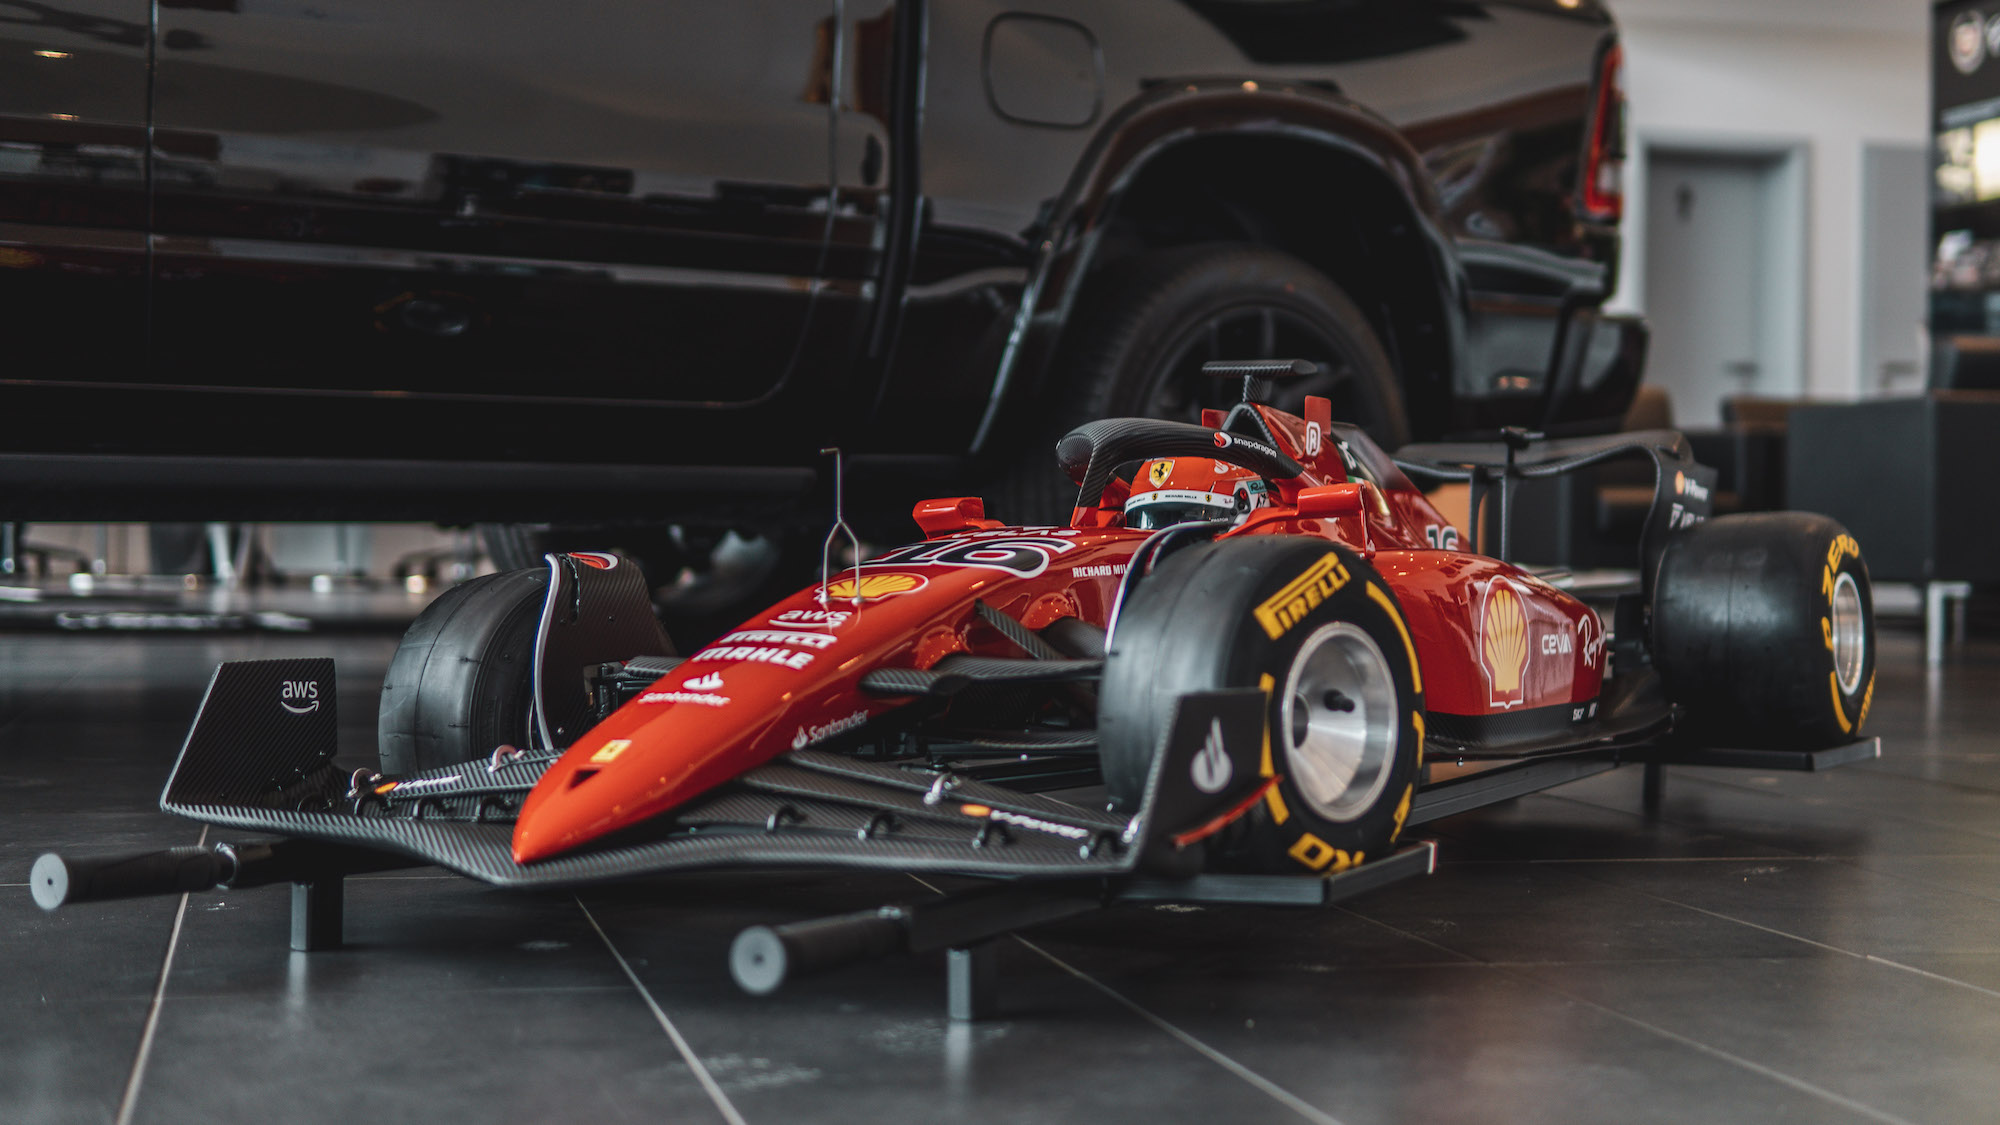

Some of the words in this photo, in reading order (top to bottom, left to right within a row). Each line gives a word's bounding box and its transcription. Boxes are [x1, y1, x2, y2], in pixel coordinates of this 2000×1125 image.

[1233, 436, 1277, 458] snapdragon
[1426, 524, 1459, 550] 16
[842, 537, 1076, 579] 16
[1072, 564, 1112, 578] RICHARD
[1113, 563, 1130, 576] MIL
[1821, 534, 1861, 606] ZERO
[1253, 551, 1351, 640] PIRELLI
[777, 609, 852, 622] aws
[719, 629, 838, 649] PIRELLI
[692, 646, 815, 670] MAHLE
[282, 680, 318, 699] aws
[638, 690, 731, 707] Santander
[806, 708, 869, 744] Santander
